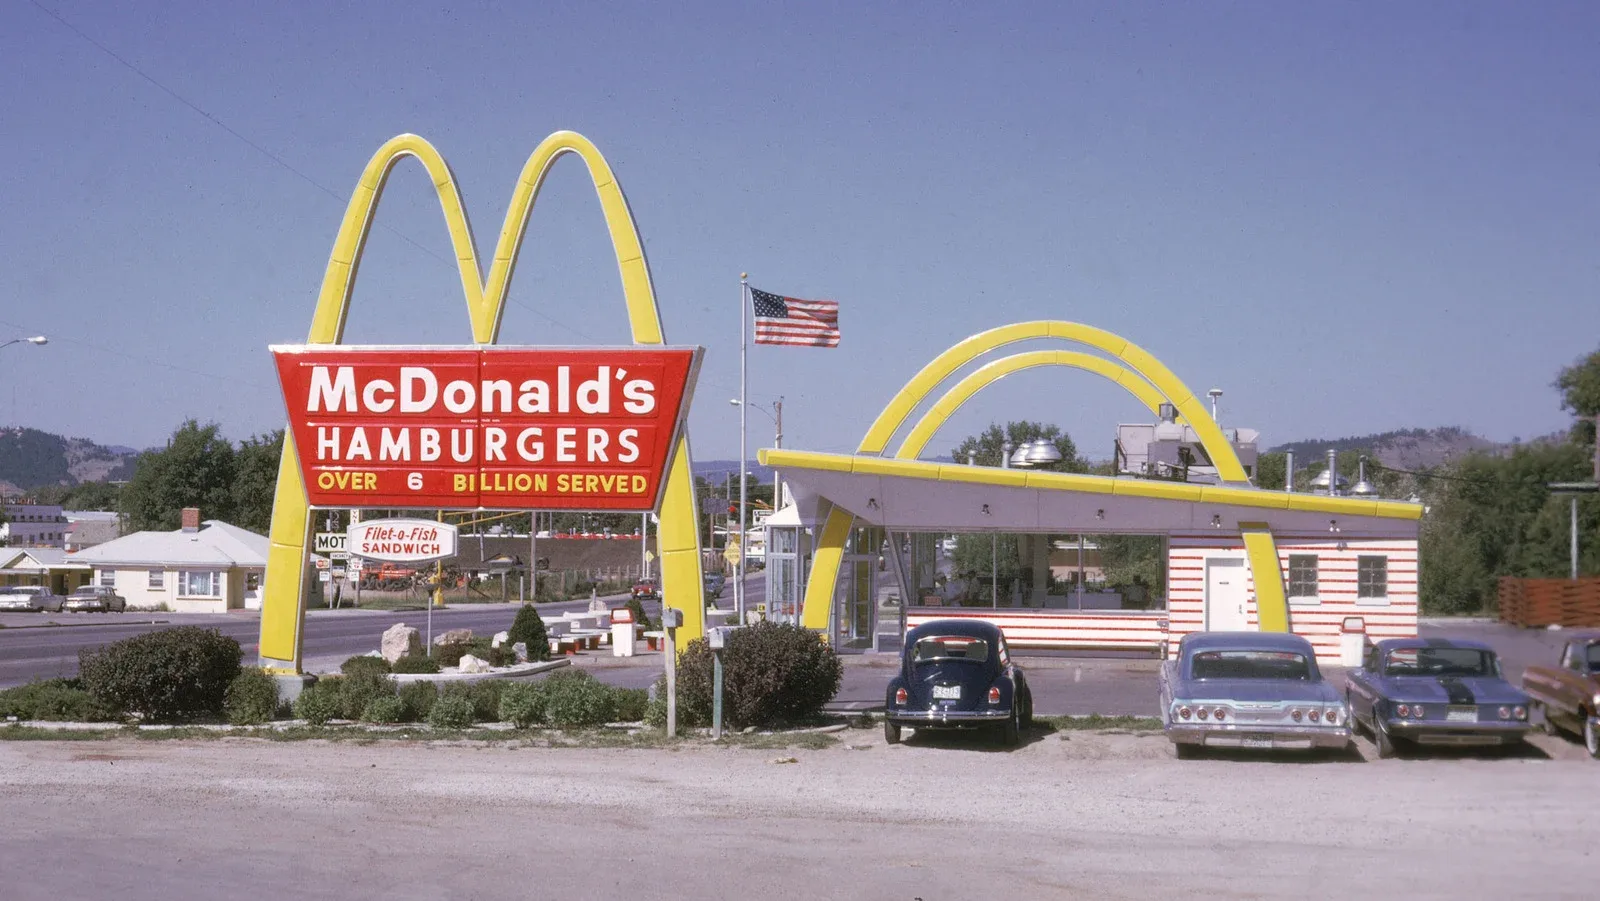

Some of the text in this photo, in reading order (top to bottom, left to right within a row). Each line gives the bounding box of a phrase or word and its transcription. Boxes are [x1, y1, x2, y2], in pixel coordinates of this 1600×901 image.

[307, 366, 655, 414] McDonald's
[317, 427, 640, 463] HAMBURGERS
[317, 472, 647, 494] OVER 6 BILLION SERVED
[318, 536, 346, 548] MOT
[364, 527, 438, 541] Filet-o-Fish
[362, 542, 440, 554] SANDWICH
